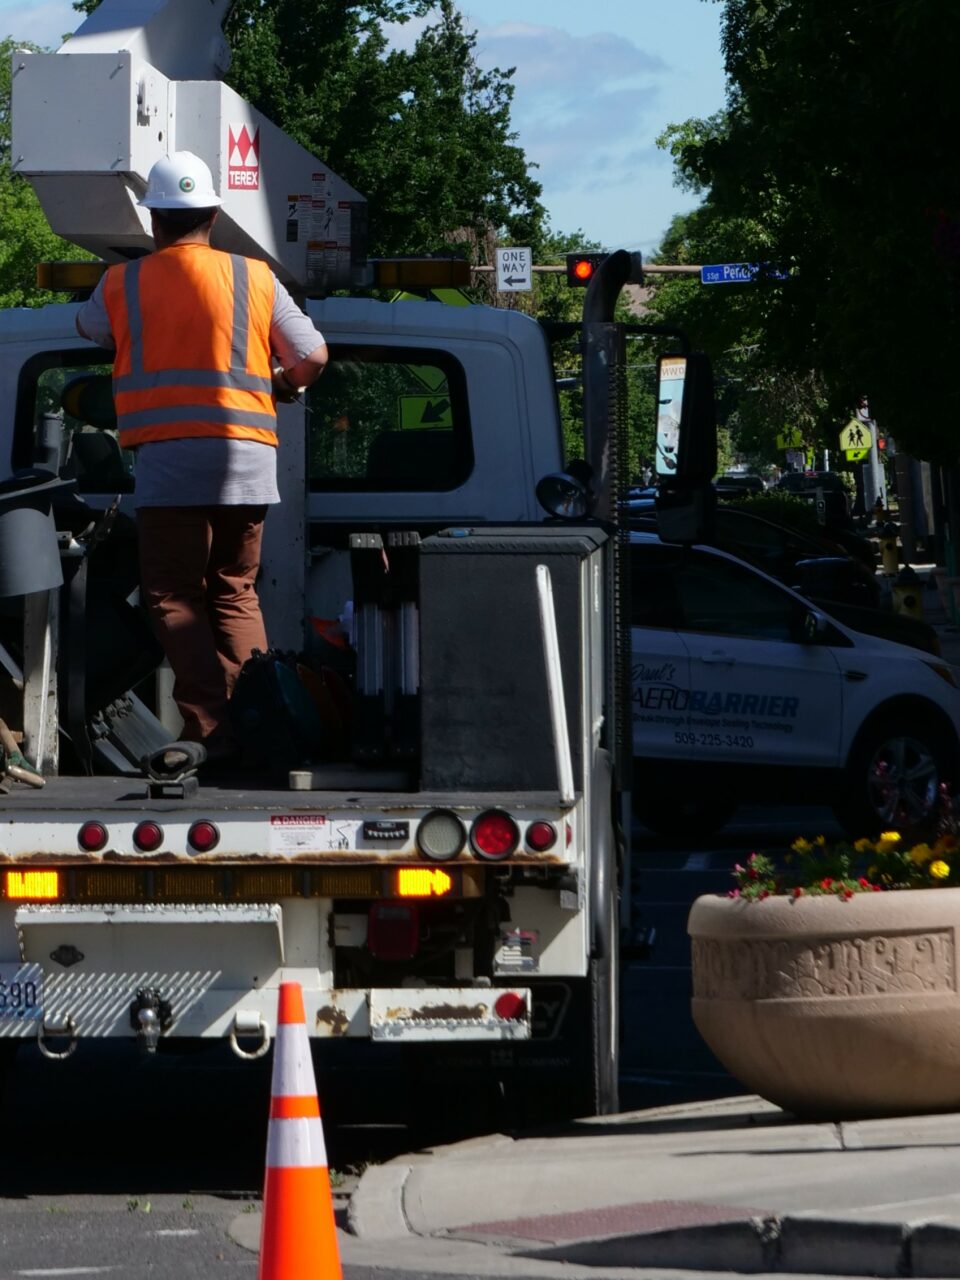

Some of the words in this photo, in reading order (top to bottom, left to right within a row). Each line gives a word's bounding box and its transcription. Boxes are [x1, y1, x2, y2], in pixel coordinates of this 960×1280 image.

[229, 170, 258, 186] TEREX
[502, 251, 526, 262] ONE
[502, 262, 527, 273] WAY
[674, 731, 755, 749] 509-225-3420
[282, 815, 324, 825] DANGER
